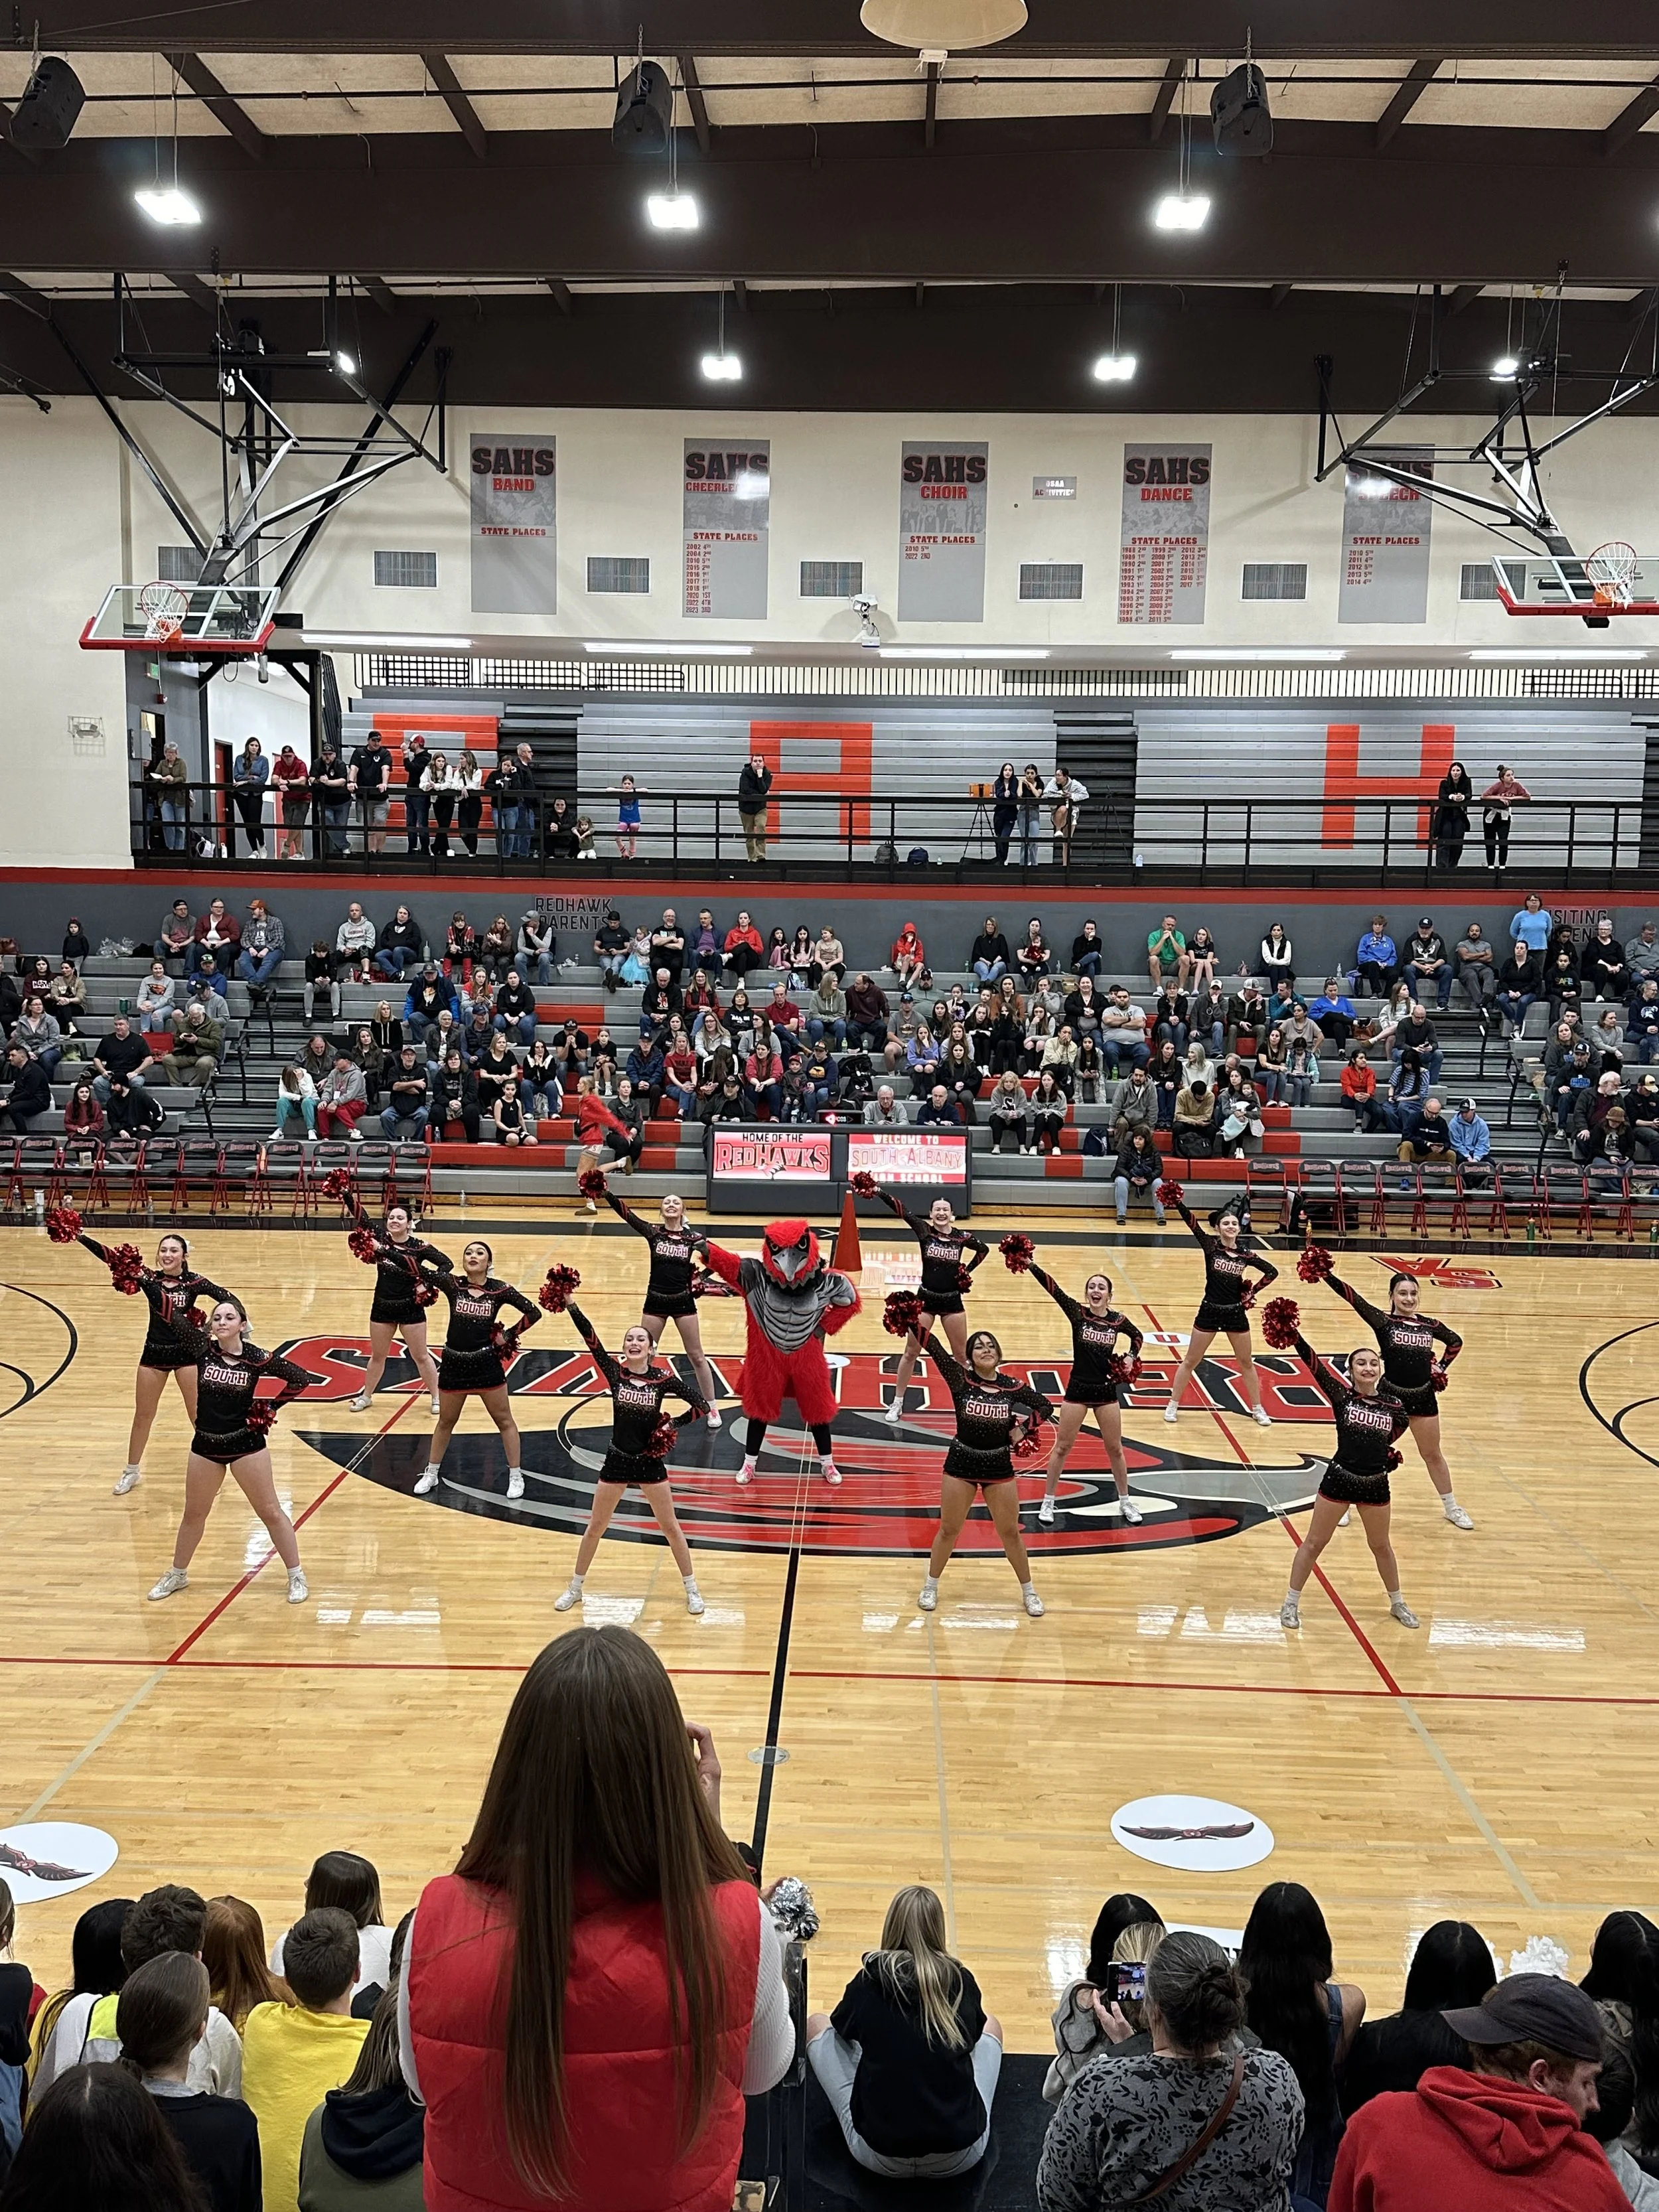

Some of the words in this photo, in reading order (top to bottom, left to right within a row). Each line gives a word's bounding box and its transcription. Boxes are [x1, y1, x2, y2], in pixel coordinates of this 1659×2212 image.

[472, 447, 554, 476] SAHS
[685, 452, 768, 479] SAHS
[903, 455, 986, 483] SAHS
[1125, 457, 1210, 484] SAHS
[492, 477, 535, 492] BAND
[920, 484, 968, 499] CHOIR
[1141, 488, 1192, 502] DANCE
[512, 528, 546, 536] PLACES
[535, 897, 612, 913] REDHAWK
[540, 915, 609, 930] PARENTS
[1548, 909, 1607, 925] ISITING
[743, 1133, 770, 1142] HOME
[772, 1134, 783, 1142] OF
[786, 1134, 803, 1143] THE
[873, 1134, 922, 1144] WELCOME
[926, 1136, 939, 1145] TO
[851, 1147, 897, 1167] SOUTH
[906, 1147, 963, 1169] ALBANY
[656, 1243, 689, 1258] SOUTH
[928, 1246, 959, 1260] SOUTH
[1214, 1258, 1245, 1274] SOUTH
[456, 1300, 492, 1317] SOUTH
[1082, 1329, 1116, 1344] SOUTH
[1394, 1331, 1433, 1347] SOUTH
[204, 1366, 248, 1386] SOUTH
[618, 1389, 656, 1406] SOUTH
[966, 1400, 1009, 1418] SOUTH
[1348, 1407, 1392, 1431] SOUTH
